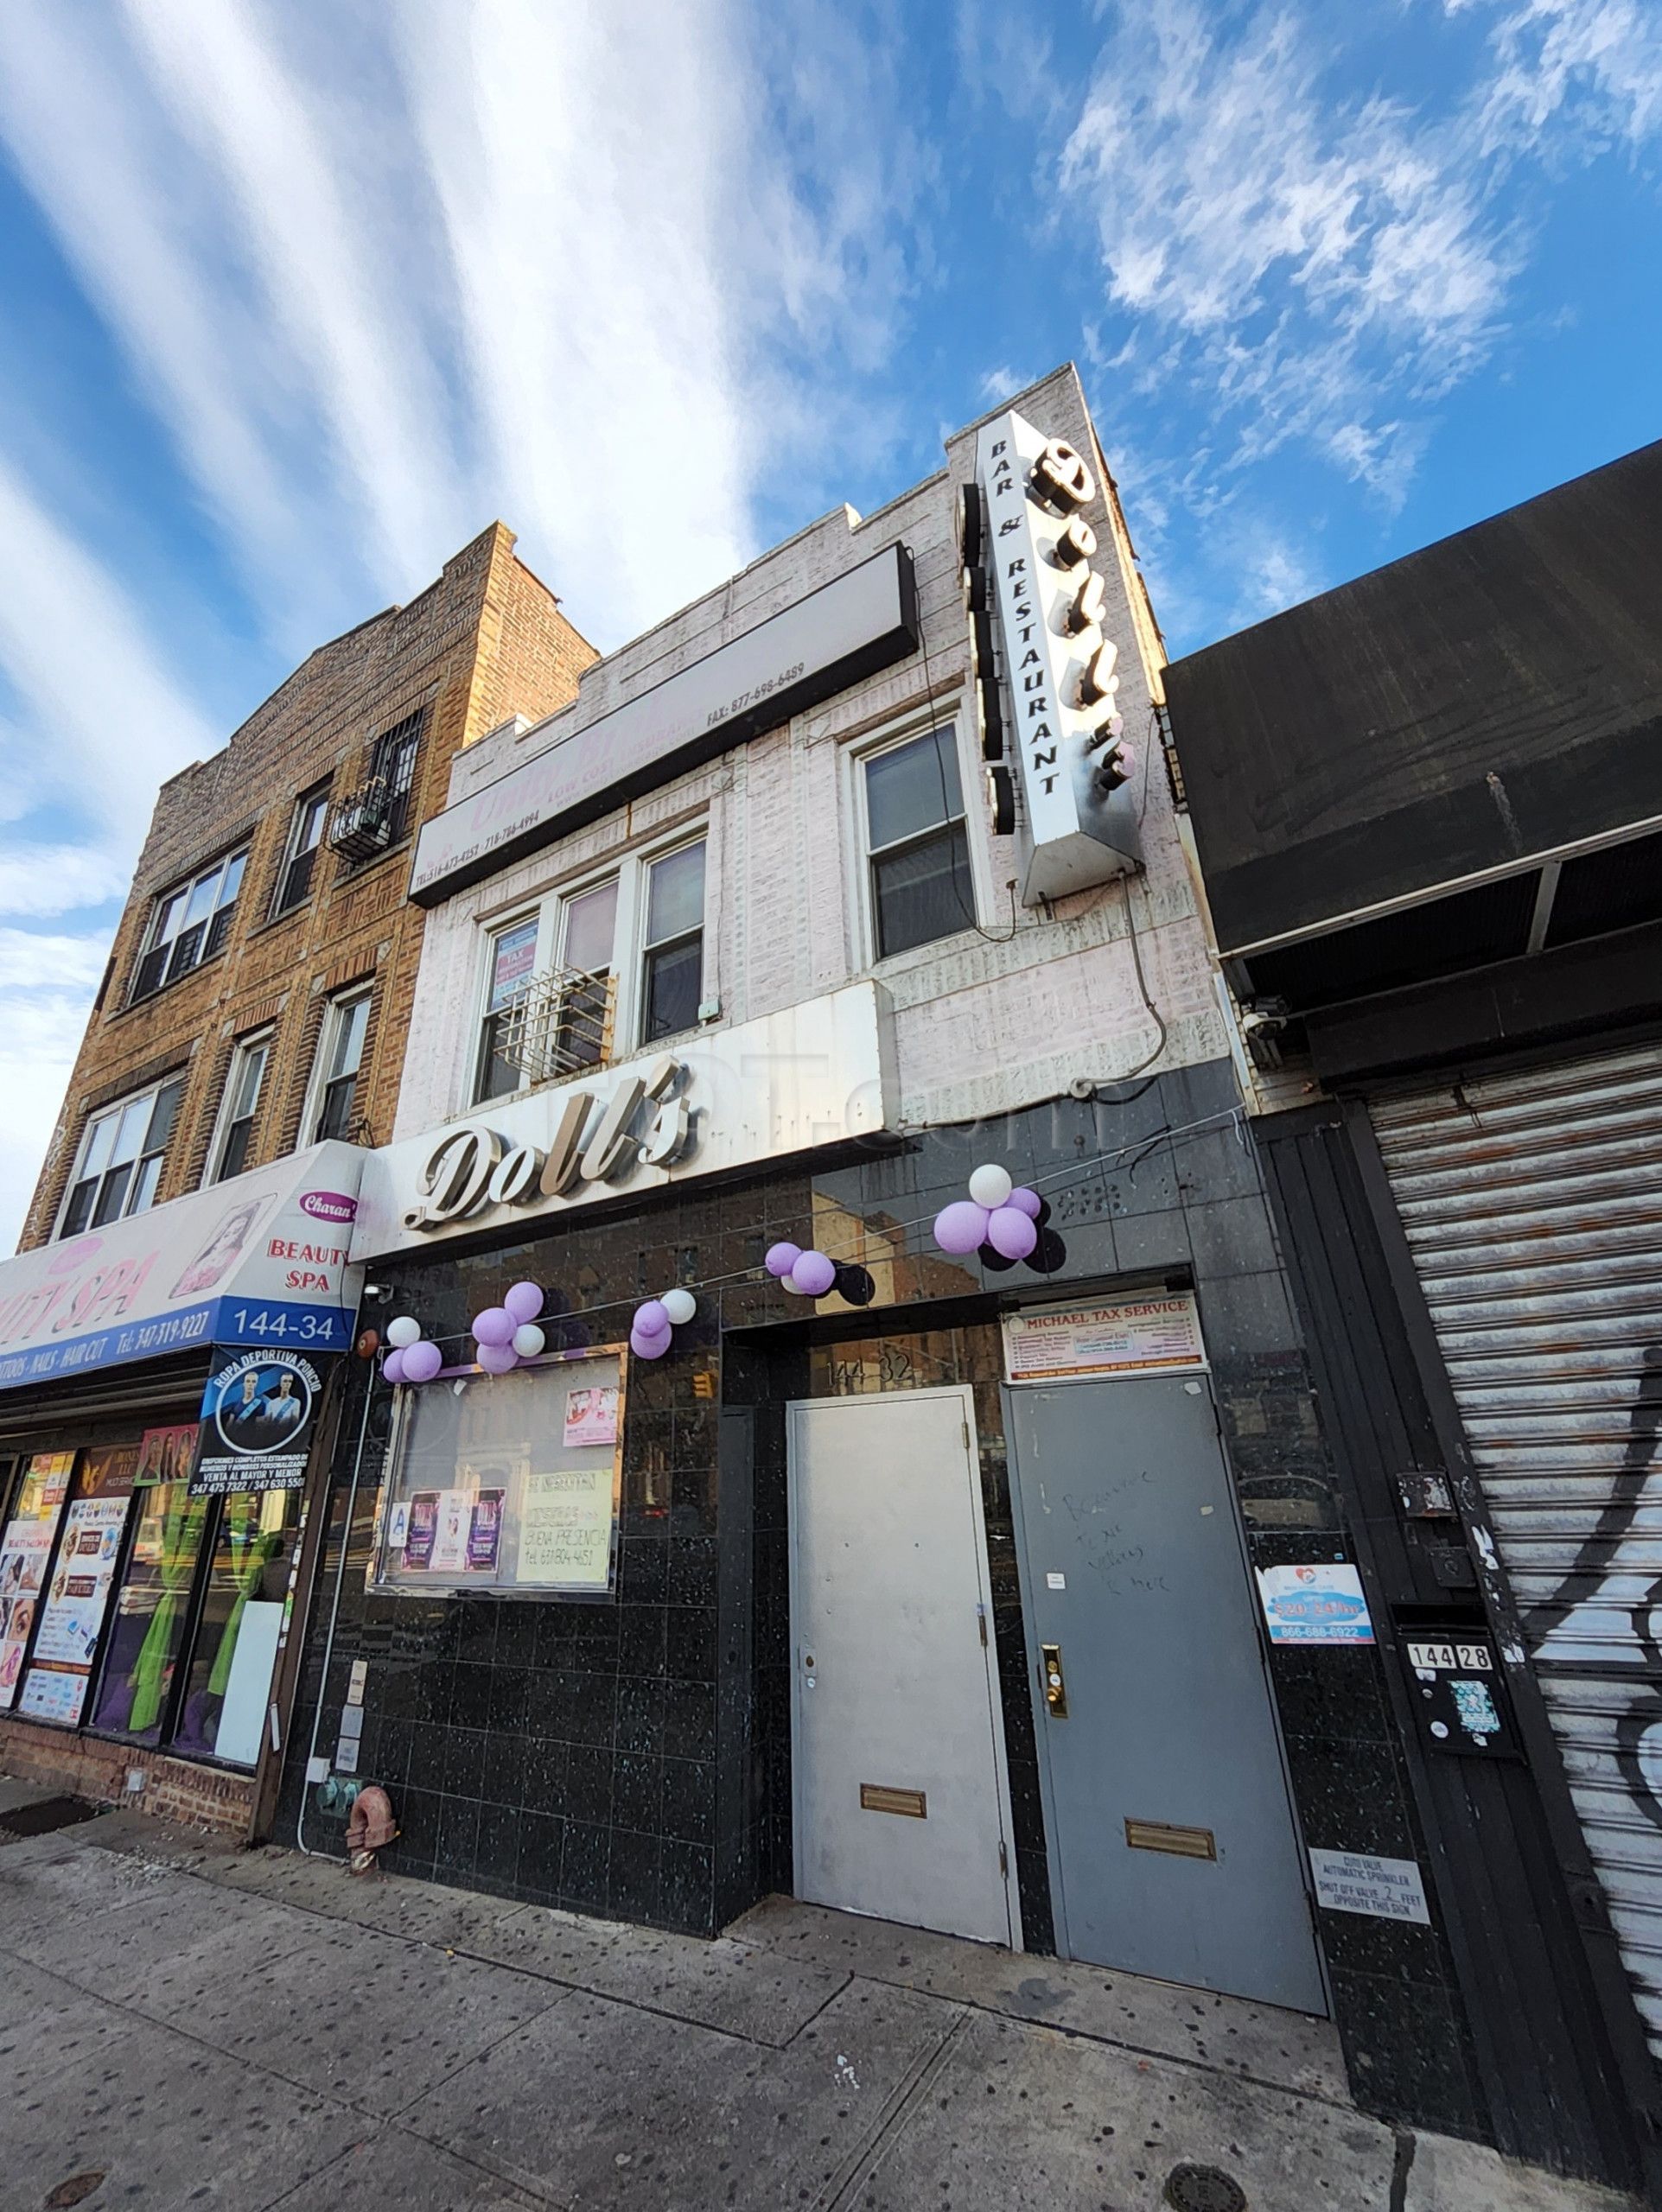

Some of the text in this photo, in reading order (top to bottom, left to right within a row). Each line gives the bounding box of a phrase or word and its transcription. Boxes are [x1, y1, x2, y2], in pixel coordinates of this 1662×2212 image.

[990, 439, 1061, 795] BAR & RESTAURANT
[707, 662, 805, 726] FAX: 877-698-6489
[506, 950, 525, 964] TAX
[286, 1270, 330, 1292] SPA
[234, 1308, 334, 1341] 144-34
[1027, 1313, 1089, 1330] MICHAEL
[1092, 1308, 1121, 1322] TAX
[1124, 1300, 1189, 1318] SERVICE
[60, 1342, 88, 1370] HAIR
[86, 1337, 109, 1363] CUT
[135, 1311, 210, 1351] 347-319-9227
[213, 1349, 322, 1393] ROPA DEPORTIVA PONCIO
[232, 1463, 260, 1471] NOMBRES
[235, 1455, 268, 1464] COMPLETOS
[268, 1453, 301, 1462] ESTAMPADO
[191, 1484, 209, 1495] 347
[208, 1482, 226, 1493] 475
[226, 1481, 247, 1492] 7322
[253, 1479, 270, 1491] 347
[270, 1478, 286, 1489] 630
[203, 1468, 302, 1483] VENTA AL MAYOR Y MENOR
[393, 1508, 404, 1535] A
[1274, 1602, 1306, 1618] $20
[1281, 1626, 1359, 1637] 866-688-6922
[1413, 1646, 1489, 1668] 144 28
[1323, 1865, 1410, 1886] AUTOMATIC SPRINKLER
[1318, 1880, 1421, 1908] SHUT OFF VALVE 2 FEET
[1334, 1894, 1411, 1916] OPPOSITE THIS SIGN
